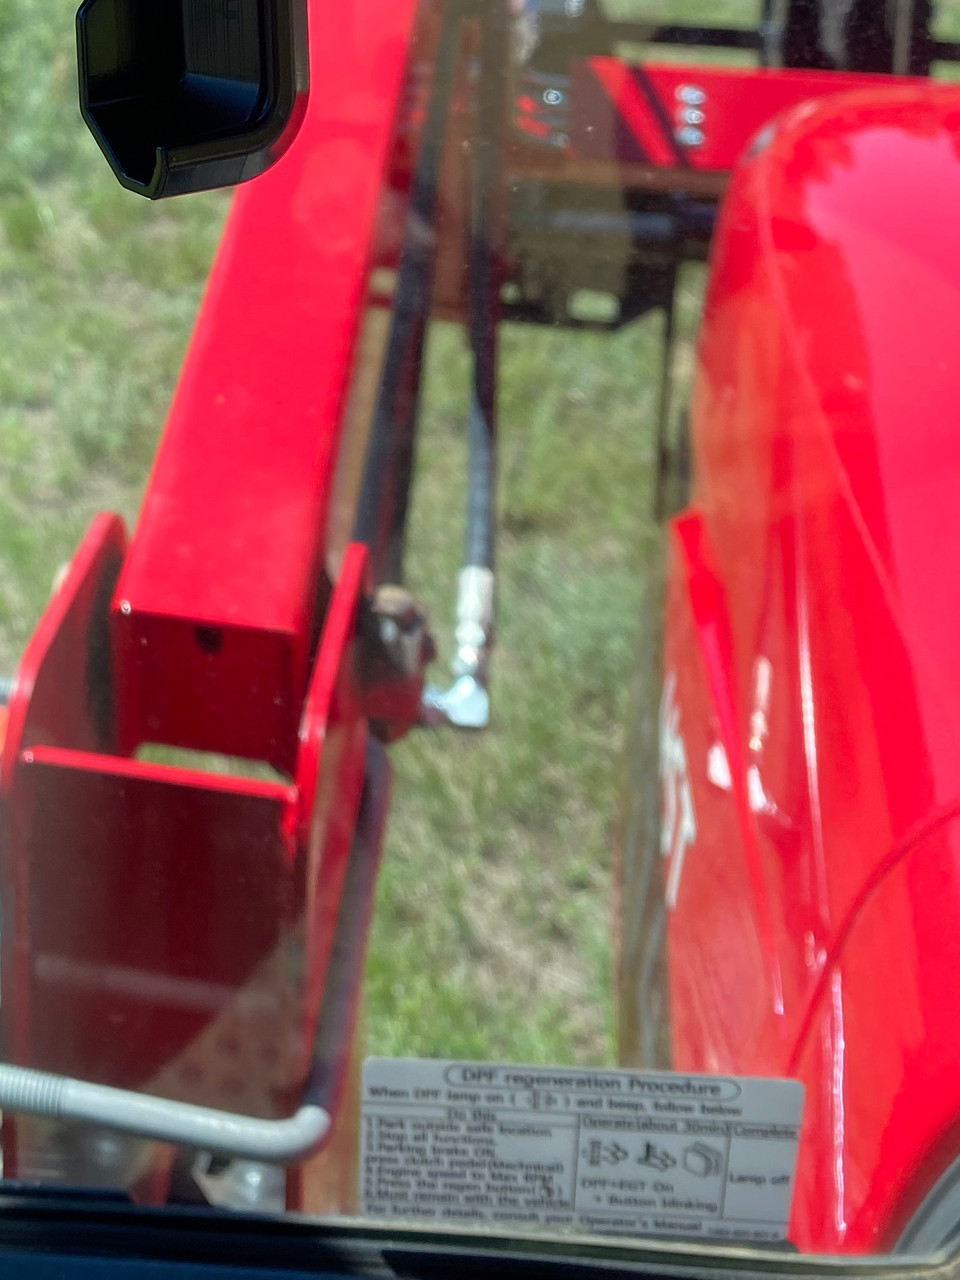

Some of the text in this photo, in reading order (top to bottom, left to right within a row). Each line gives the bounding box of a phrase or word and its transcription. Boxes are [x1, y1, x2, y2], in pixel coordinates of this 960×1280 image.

[463, 1068, 721, 1095] DPF regeneration Procedure
[370, 1087, 409, 1097] When
[448, 1090, 480, 1102] lamp
[577, 1098, 602, 1108] and
[654, 1102, 694, 1113] follow
[702, 1104, 742, 1115] below
[734, 1126, 796, 1138] Complete
[729, 1173, 766, 1185] Lamp
[608, 1194, 656, 1207] Button
